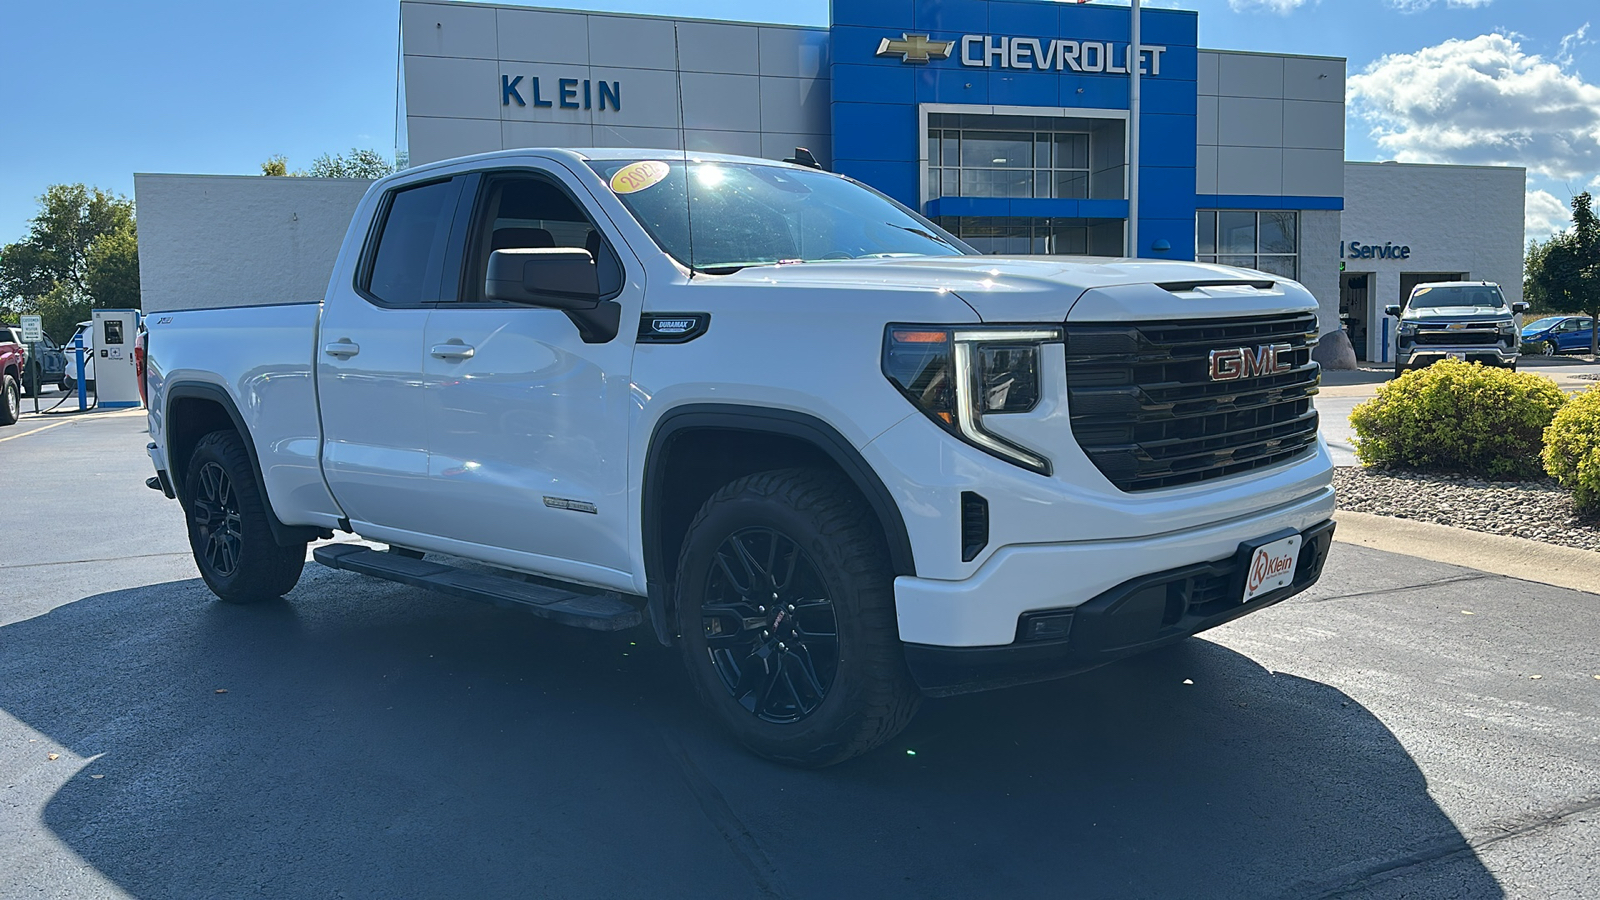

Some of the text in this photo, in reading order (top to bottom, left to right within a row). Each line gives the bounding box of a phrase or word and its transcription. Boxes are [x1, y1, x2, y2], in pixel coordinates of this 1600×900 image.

[502, 74, 621, 112] KLEIN
[620, 163, 661, 189] 2022
[1349, 241, 1411, 259] Service
[1209, 343, 1292, 381] GMC
[1267, 554, 1292, 575] Klein
